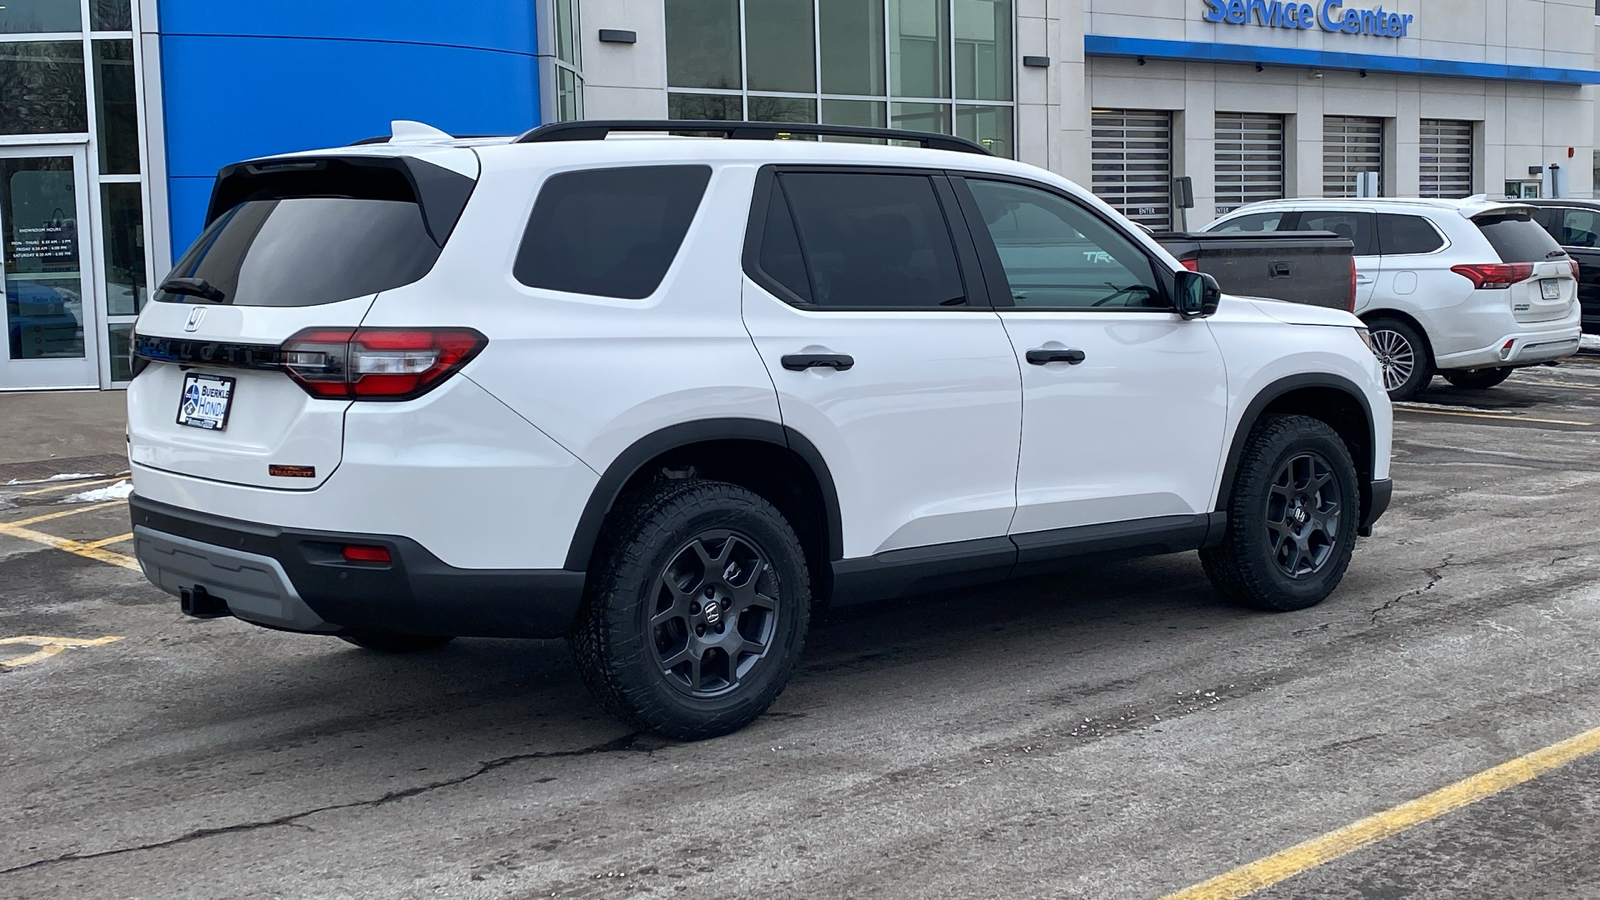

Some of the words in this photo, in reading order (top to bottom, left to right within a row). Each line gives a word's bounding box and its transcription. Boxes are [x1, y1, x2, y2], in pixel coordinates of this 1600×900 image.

[1203, 0, 1314, 29] Service
[1317, 0, 1413, 38] Center
[1138, 207, 1155, 215] ENTER
[1083, 251, 1115, 264] TR
[201, 385, 230, 399] BUERKLE
